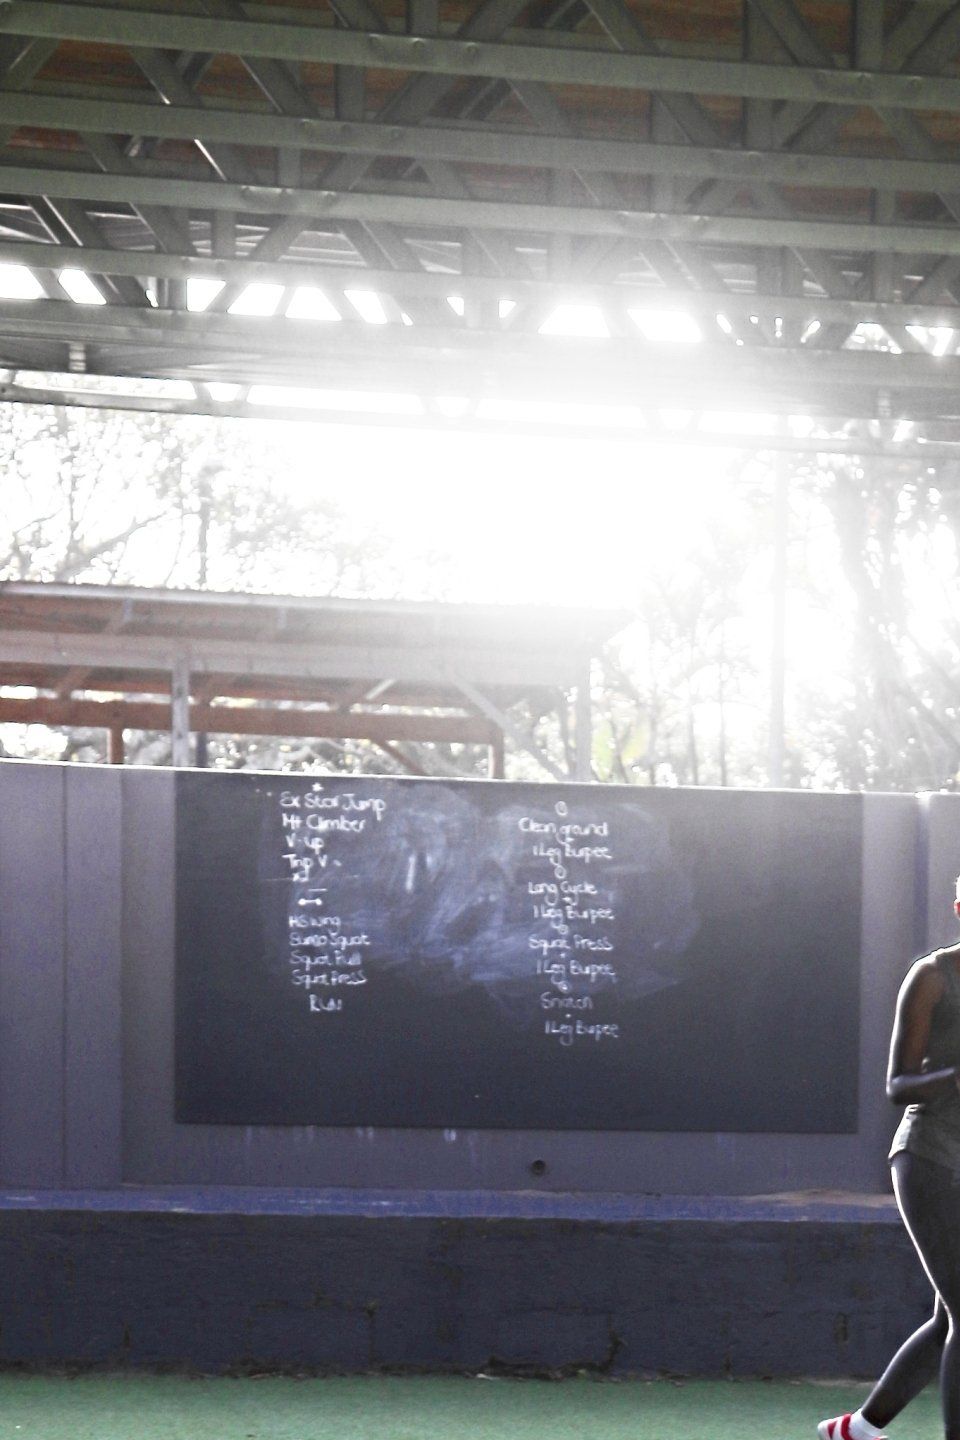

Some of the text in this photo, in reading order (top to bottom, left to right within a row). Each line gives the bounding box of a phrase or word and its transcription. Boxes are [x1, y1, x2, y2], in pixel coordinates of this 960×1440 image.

[304, 792, 340, 808] Star
[341, 793, 386, 821] Jump
[528, 882, 560, 906] Long
[573, 934, 614, 951] Press
